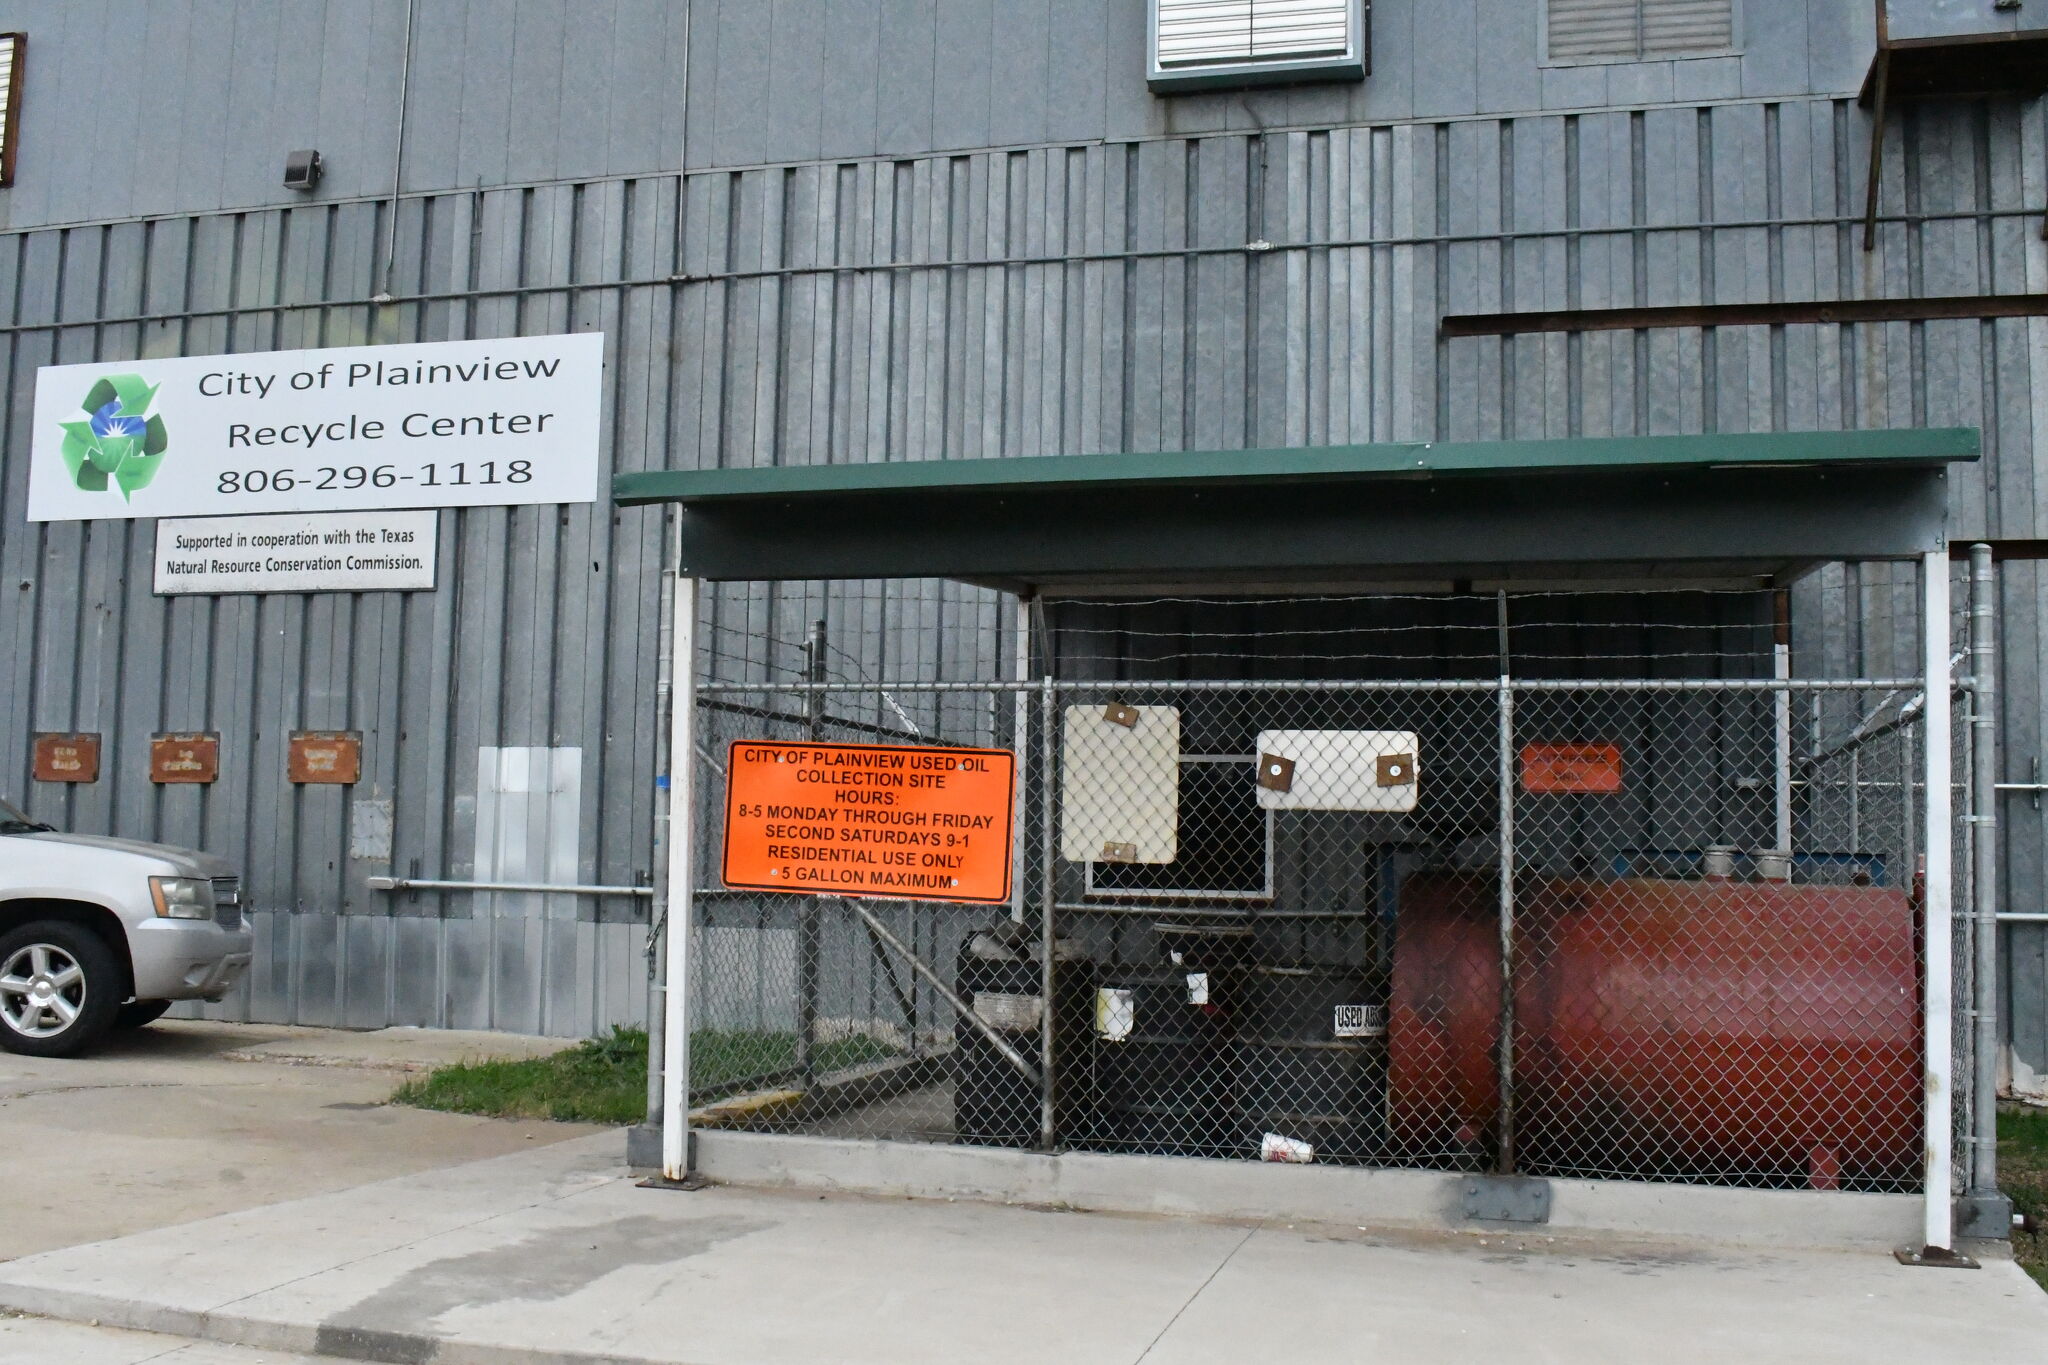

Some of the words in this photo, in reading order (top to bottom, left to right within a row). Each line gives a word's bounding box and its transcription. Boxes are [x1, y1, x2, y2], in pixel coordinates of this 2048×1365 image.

[199, 371, 276, 400] City
[290, 363, 334, 391] of
[348, 356, 561, 388] Plainview
[229, 414, 385, 449] Recycle
[401, 411, 554, 438] Center
[216, 459, 534, 494] 806-296-1118
[175, 532, 233, 552] Supported
[237, 532, 247, 548] in
[251, 530, 319, 550] cooperation
[323, 529, 351, 545] with
[355, 528, 376, 544] the
[380, 528, 414, 544] Texas
[166, 558, 207, 575] Natural
[211, 558, 261, 574] Resource
[265, 555, 342, 572] Conservation
[346, 554, 423, 571] Commission.
[744, 749, 782, 764] CITY
[786, 750, 808, 765] OF
[813, 751, 905, 769] PLAINVIEW
[910, 755, 959, 771] USED
[962, 757, 989, 773] OIL
[796, 769, 902, 787] COLLECTION
[908, 773, 946, 789] SITE
[835, 789, 899, 806] HOURS:
[738, 804, 762, 818] 8-5
[767, 805, 839, 822] MONDAY
[843, 808, 927, 827] THROUGH
[932, 813, 994, 830] FRIDAY
[765, 824, 835, 841] SECOND
[840, 828, 941, 847] SATURDAYS
[946, 833, 970, 848] 9-1
[768, 845, 878, 864] RESIDENTIAL
[882, 851, 917, 867] USE
[921, 854, 964, 869] ONLY
[782, 866, 791, 880] 5
[795, 867, 864, 884] GALLON
[870, 871, 952, 889] MAXIMUM
[1337, 1006, 1362, 1028] USED
